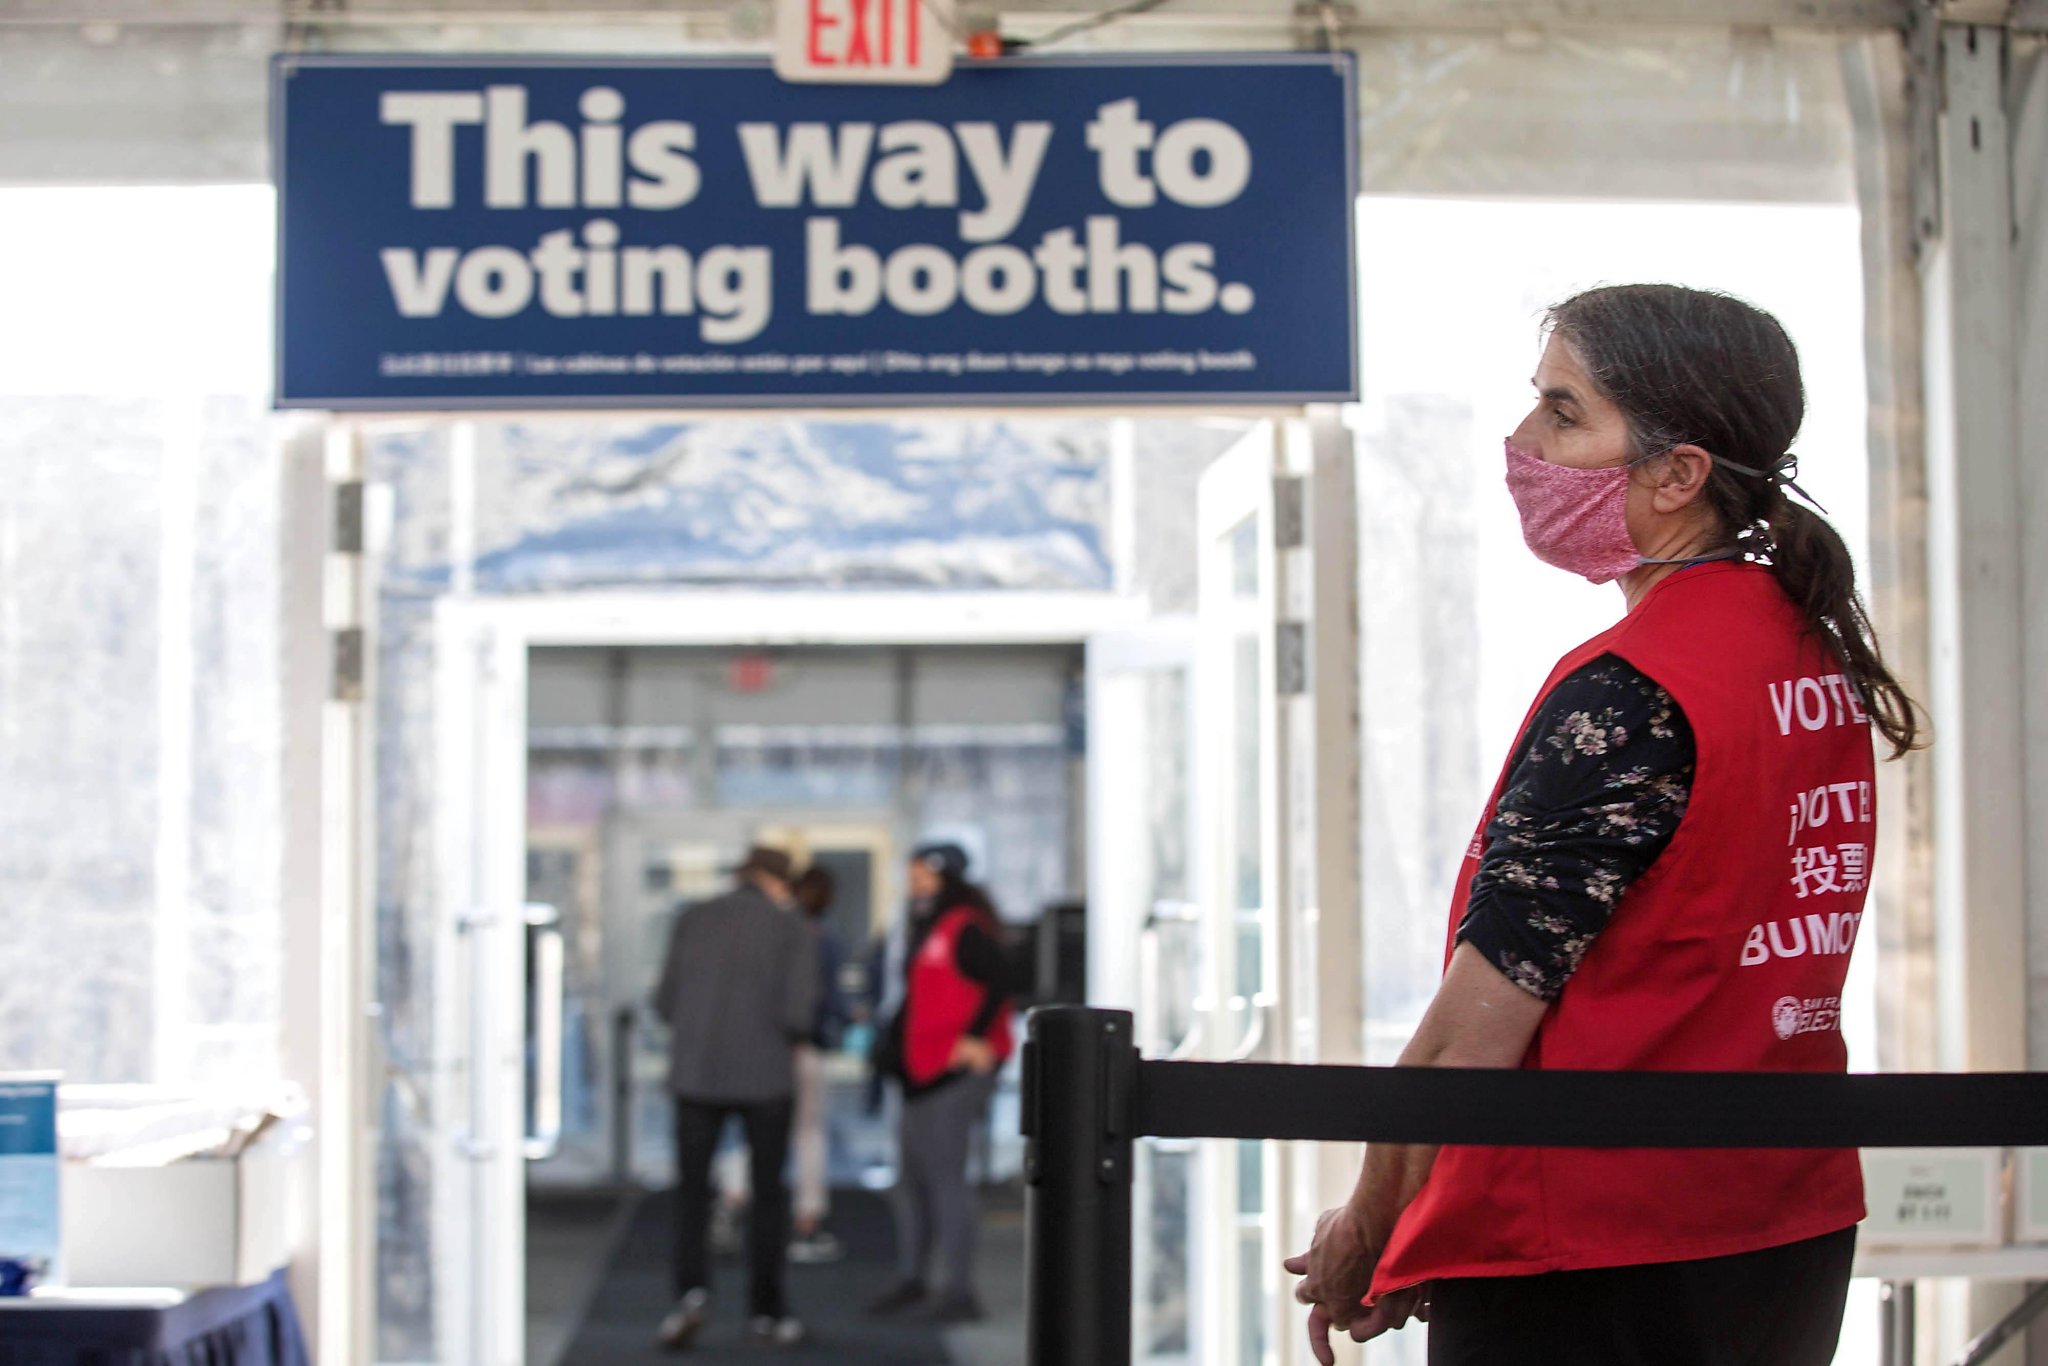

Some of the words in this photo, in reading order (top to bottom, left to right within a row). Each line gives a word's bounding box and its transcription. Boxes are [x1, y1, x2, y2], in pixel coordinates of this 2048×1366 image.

[807, 0, 920, 66] EXIT
[381, 86, 700, 209] This
[738, 121, 1052, 242] way
[1086, 98, 1251, 207] to
[381, 219, 772, 343] voting
[807, 216, 1254, 314] booths.
[1789, 842, 1868, 899] 投票
